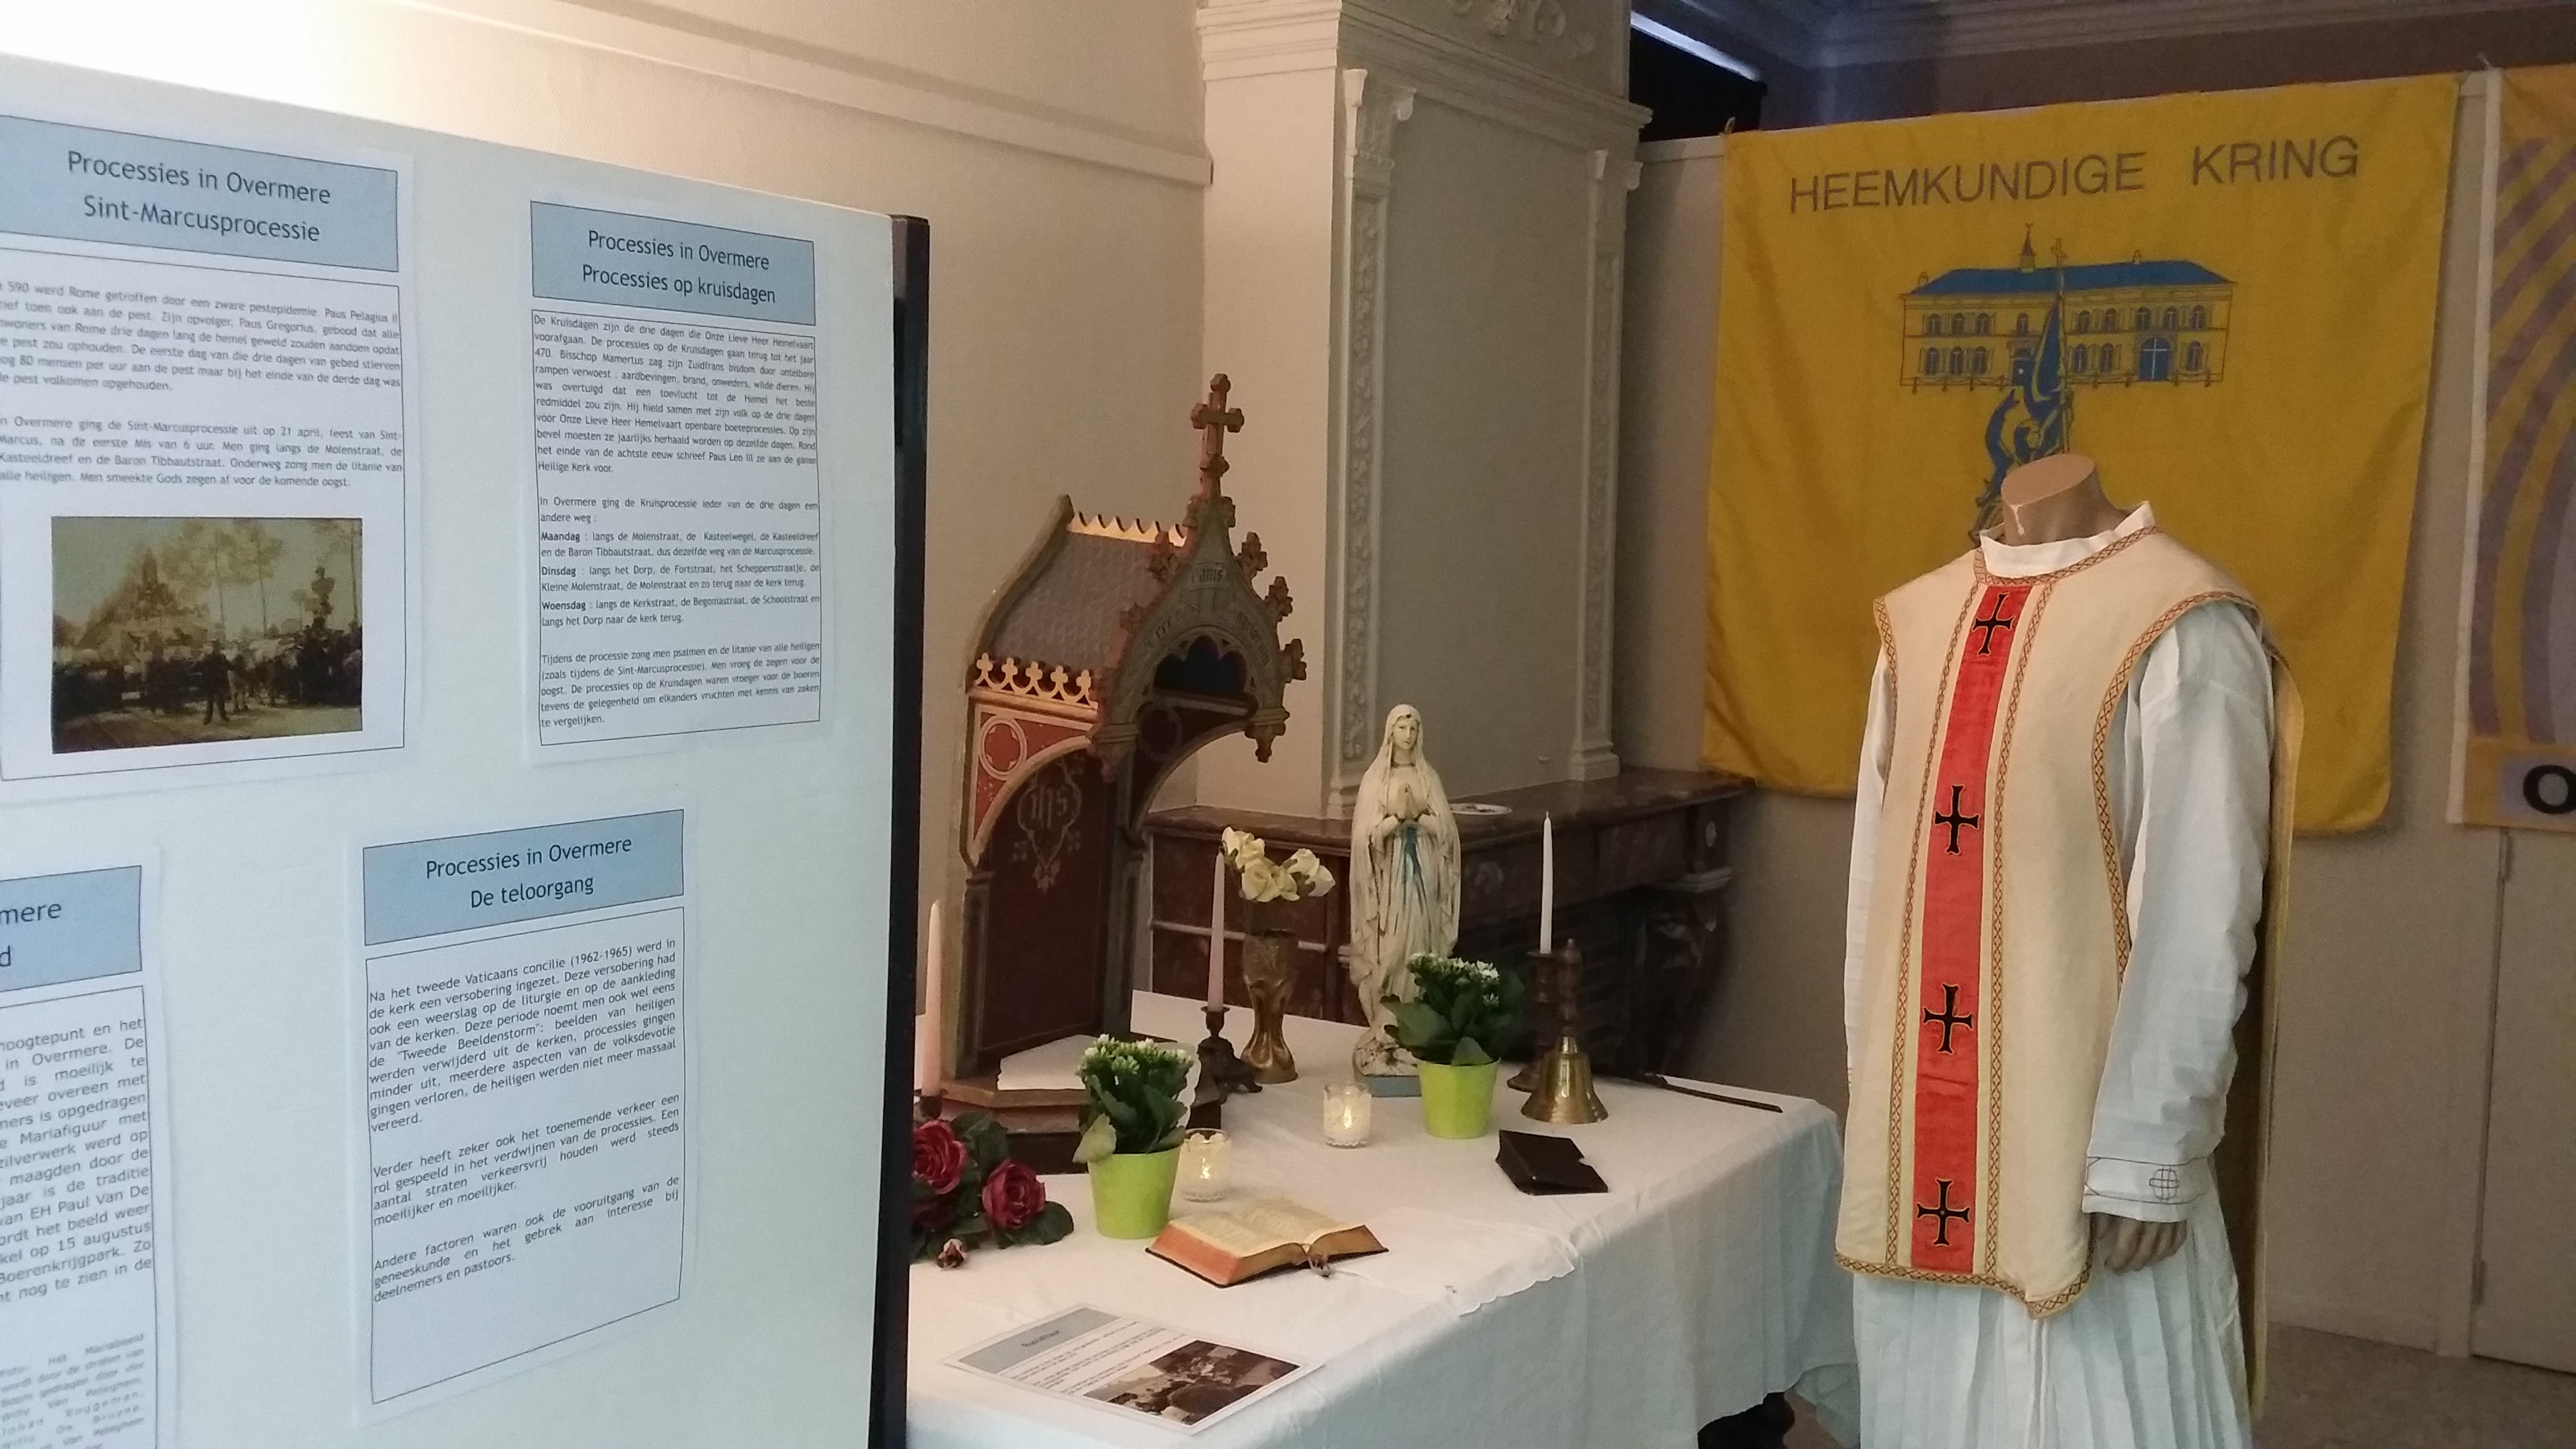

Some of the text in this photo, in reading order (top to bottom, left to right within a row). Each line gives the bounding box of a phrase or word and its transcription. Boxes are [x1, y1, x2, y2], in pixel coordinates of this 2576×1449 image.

[69, 150, 330, 204] Processies in Overmere
[1790, 134, 2360, 213] HEEMKUNDIGE KRING
[84, 195, 320, 242] Sint-Marcusprocessie
[589, 230, 769, 271] Processies in Overmere
[583, 264, 775, 305] Processies op kruisdagen
[427, 839, 632, 879] Processies in Overmere
[471, 877, 593, 909] De teloorgang
[369, 938, 675, 1003] Na het tweede Vaticaans concilie (1962-1965) werd in
[369, 1007, 385, 1020] de
[389, 1000, 415, 1016] kerk
[419, 998, 441, 1010] een
[445, 984, 512, 1004] versobering
[565, 970, 590, 982] Deze
[593, 957, 653, 977] versobering
[658, 951, 675, 965] had
[369, 968, 675, 1037] ook een weerslag op de liturgie en op de aankleding
[369, 1040, 391, 1051] van
[395, 1034, 411, 1047] de
[465, 1019, 492, 1033] Deze
[497, 1008, 539, 1029] periode
[544, 1000, 579, 1017] noemt
[582, 997, 605, 1009] men
[608, 990, 628, 1004] ook
[630, 985, 648, 999] wel
[653, 983, 675, 995] eens
[93, 1025, 111, 1037] en
[119, 1017, 144, 1032] het
[6, 1058, 20, 1070] in
[124, 1037, 144, 1050] De
[369, 1067, 414, 1085] werden
[422, 1048, 486, 1072] verwijderd
[494, 1045, 509, 1058] uit
[515, 1042, 529, 1053] de
[584, 1020, 637, 1042] processies
[641, 1012, 675, 1028] gingen
[373, 1180, 390, 1195] rol
[396, 1164, 448, 1191] gespeeld
[454, 1163, 464, 1174] in
[470, 1156, 489, 1170] het
[494, 1140, 555, 1163] verdwijnen
[560, 1134, 578, 1146] van
[583, 1129, 596, 1140] de
[661, 1108, 679, 1120] Een
[30, 1204, 51, 1220] EH
[58, 1195, 90, 1214] Paul
[95, 1191, 125, 1206] Van
[130, 1184, 149, 1199] De
[43, 1186, 56, 1198] is
[66, 1179, 85, 1194] de
[96, 1166, 149, 1187] traditie
[373, 1202, 435, 1227] moeilijker
[439, 1197, 452, 1209] en
[30, 1221, 150, 1259] op 15 augustus
[18, 1257, 152, 1299] nog te zien in de
